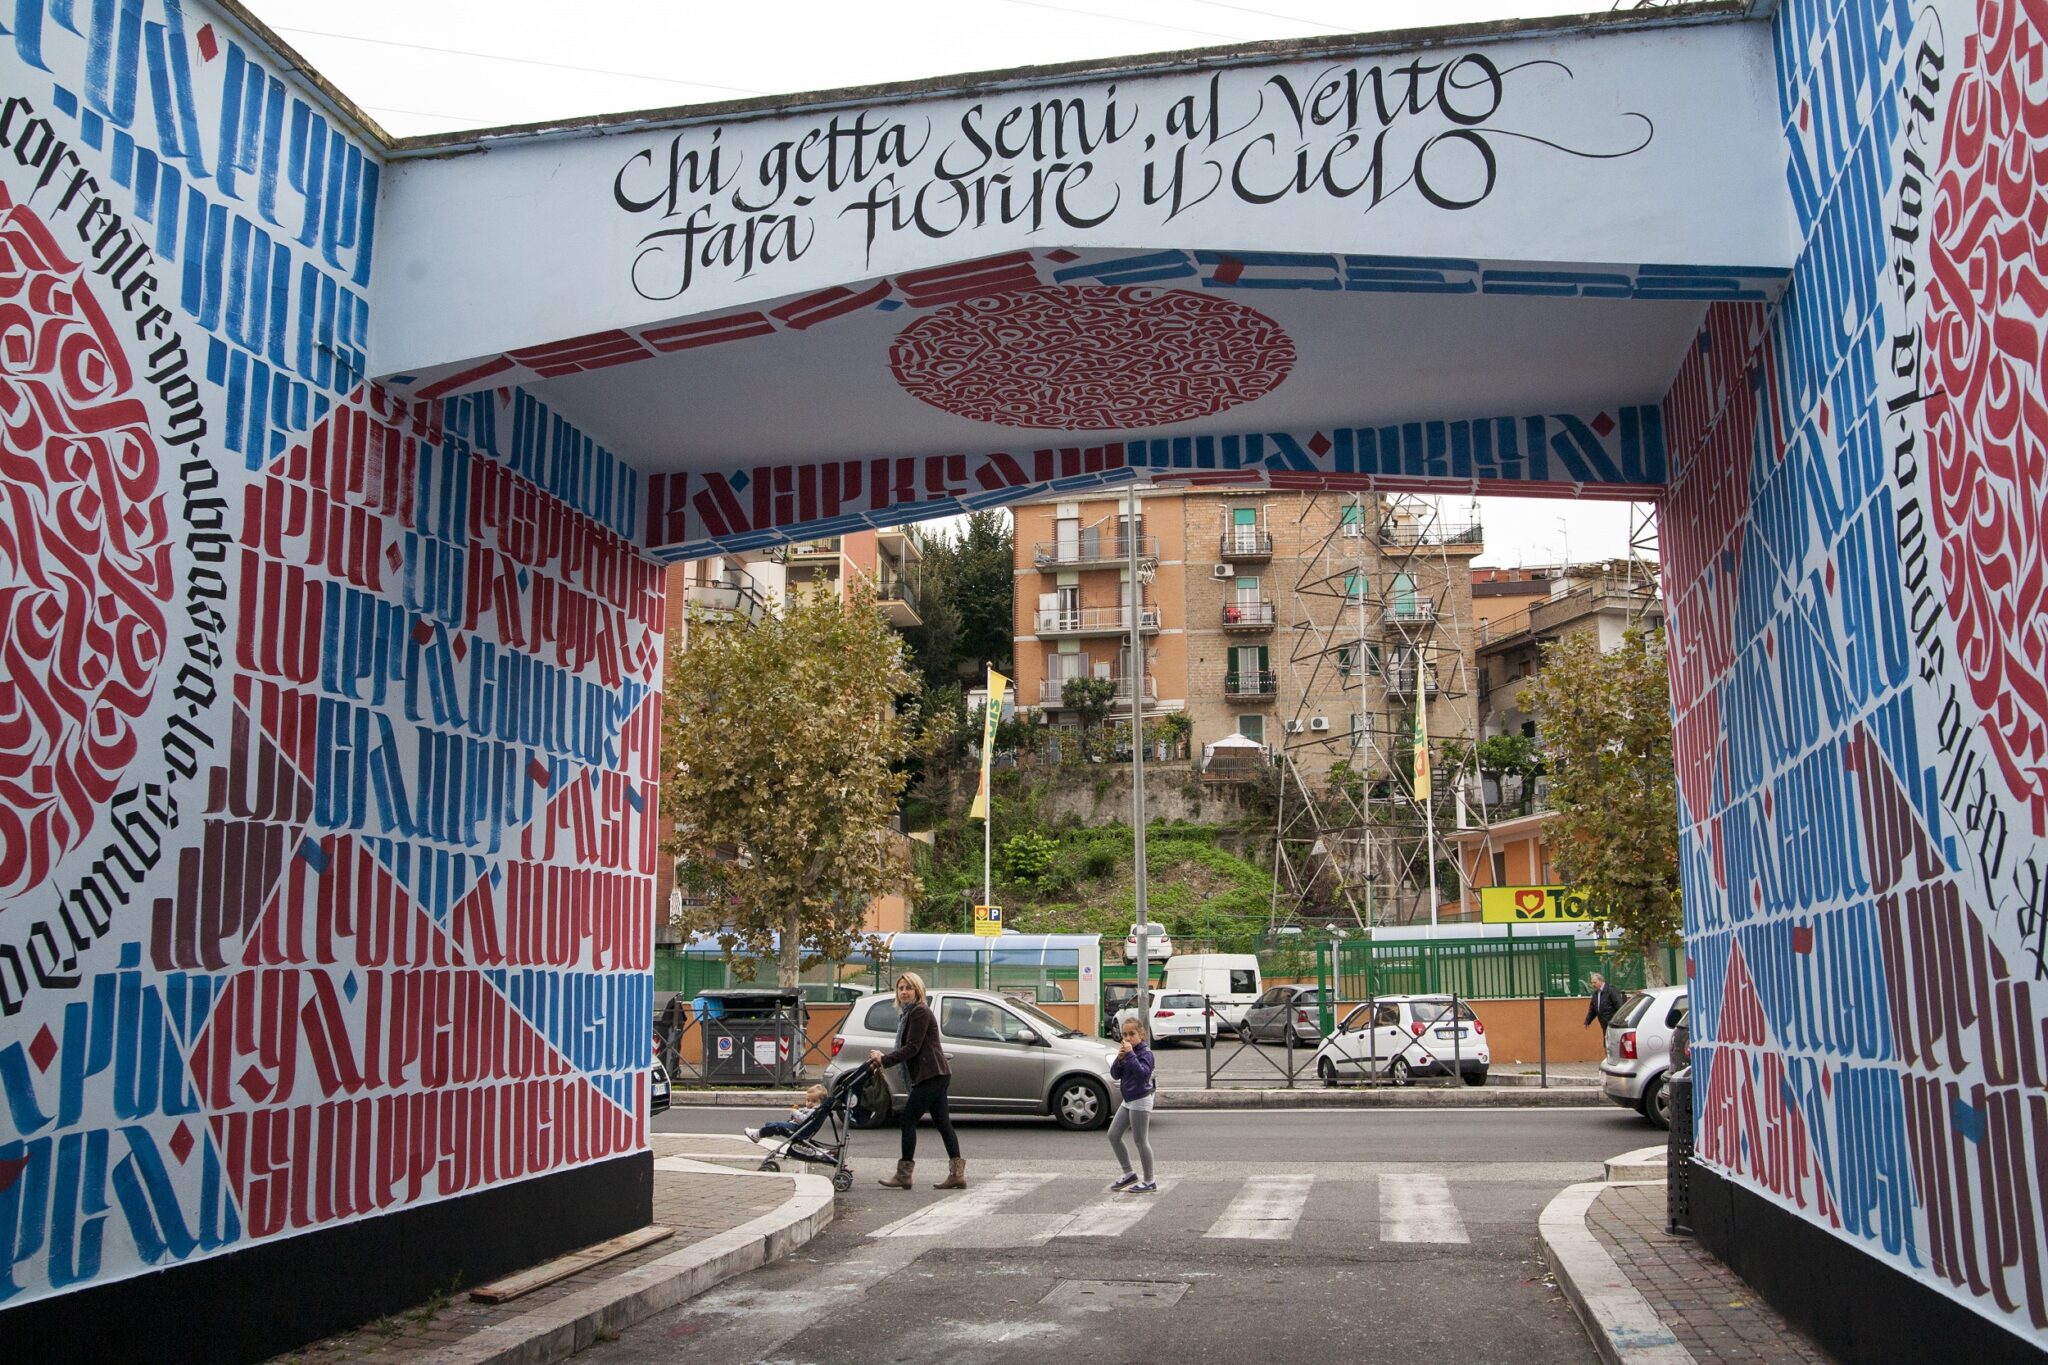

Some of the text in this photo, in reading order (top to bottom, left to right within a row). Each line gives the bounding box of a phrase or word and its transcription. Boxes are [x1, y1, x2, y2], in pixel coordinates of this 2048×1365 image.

[613, 126, 743, 219] Chi
[731, 109, 932, 213] getta
[1165, 70, 1263, 154] al
[837, 160, 1121, 271] fiorire
[1142, 135, 1223, 226] il
